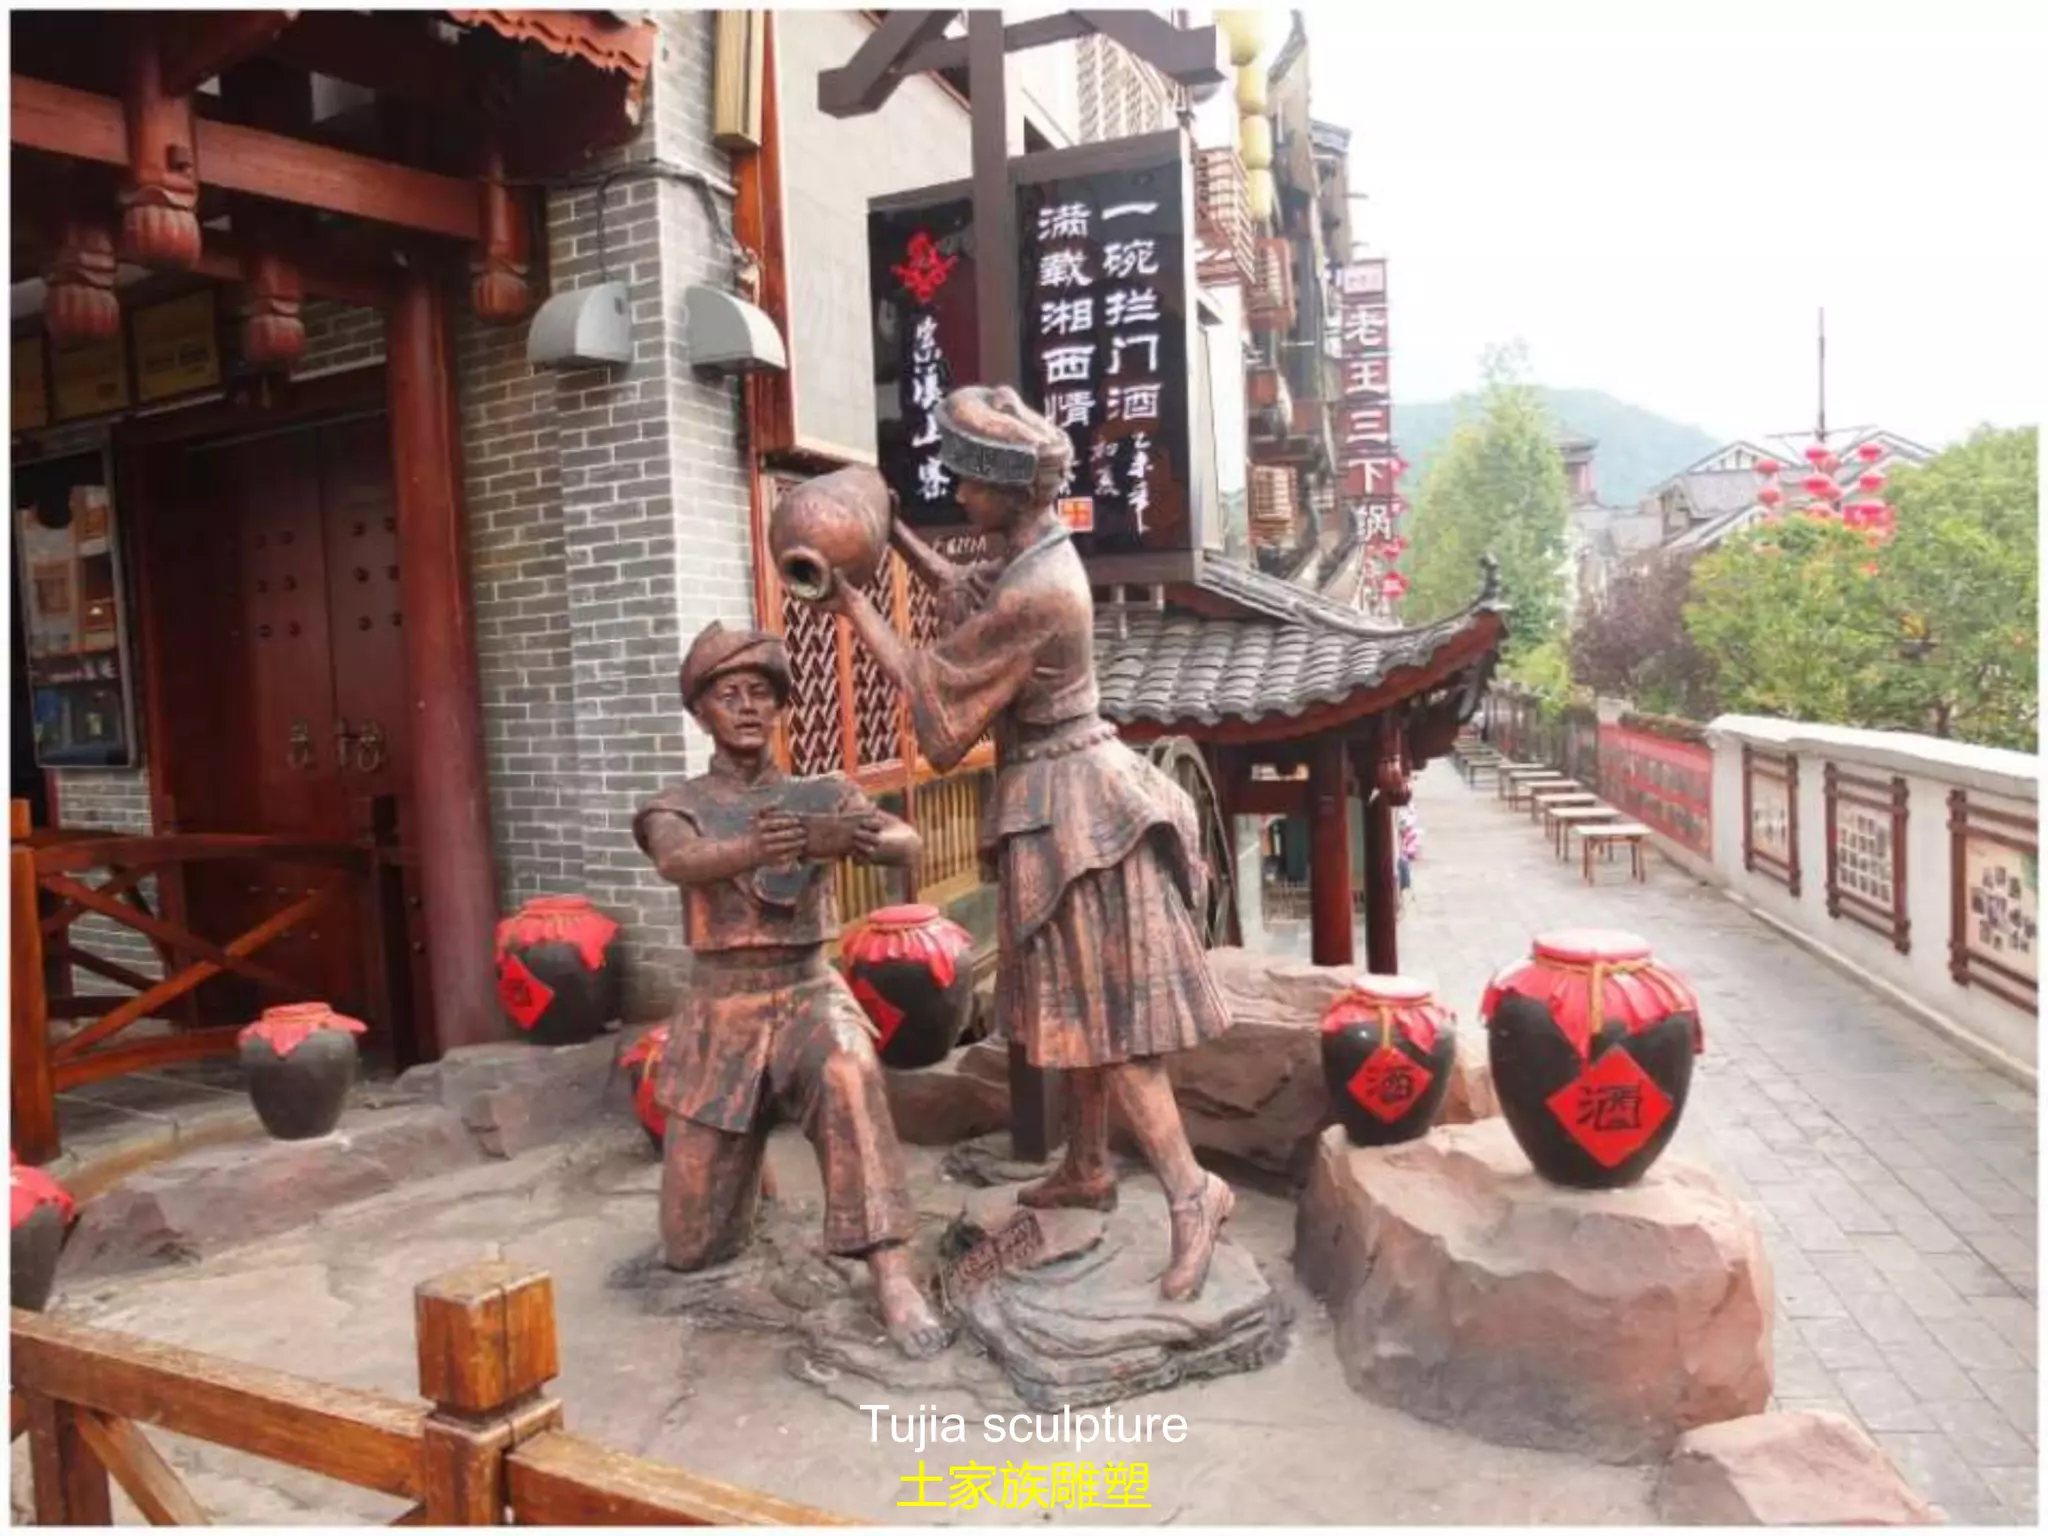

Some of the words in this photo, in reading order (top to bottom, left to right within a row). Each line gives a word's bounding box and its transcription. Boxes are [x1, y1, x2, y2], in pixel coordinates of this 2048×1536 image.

[1101, 201, 1161, 419] 一碗拦门酒
[1364, 1064, 1415, 1105] 酒
[1576, 1082, 1643, 1132] 酒
